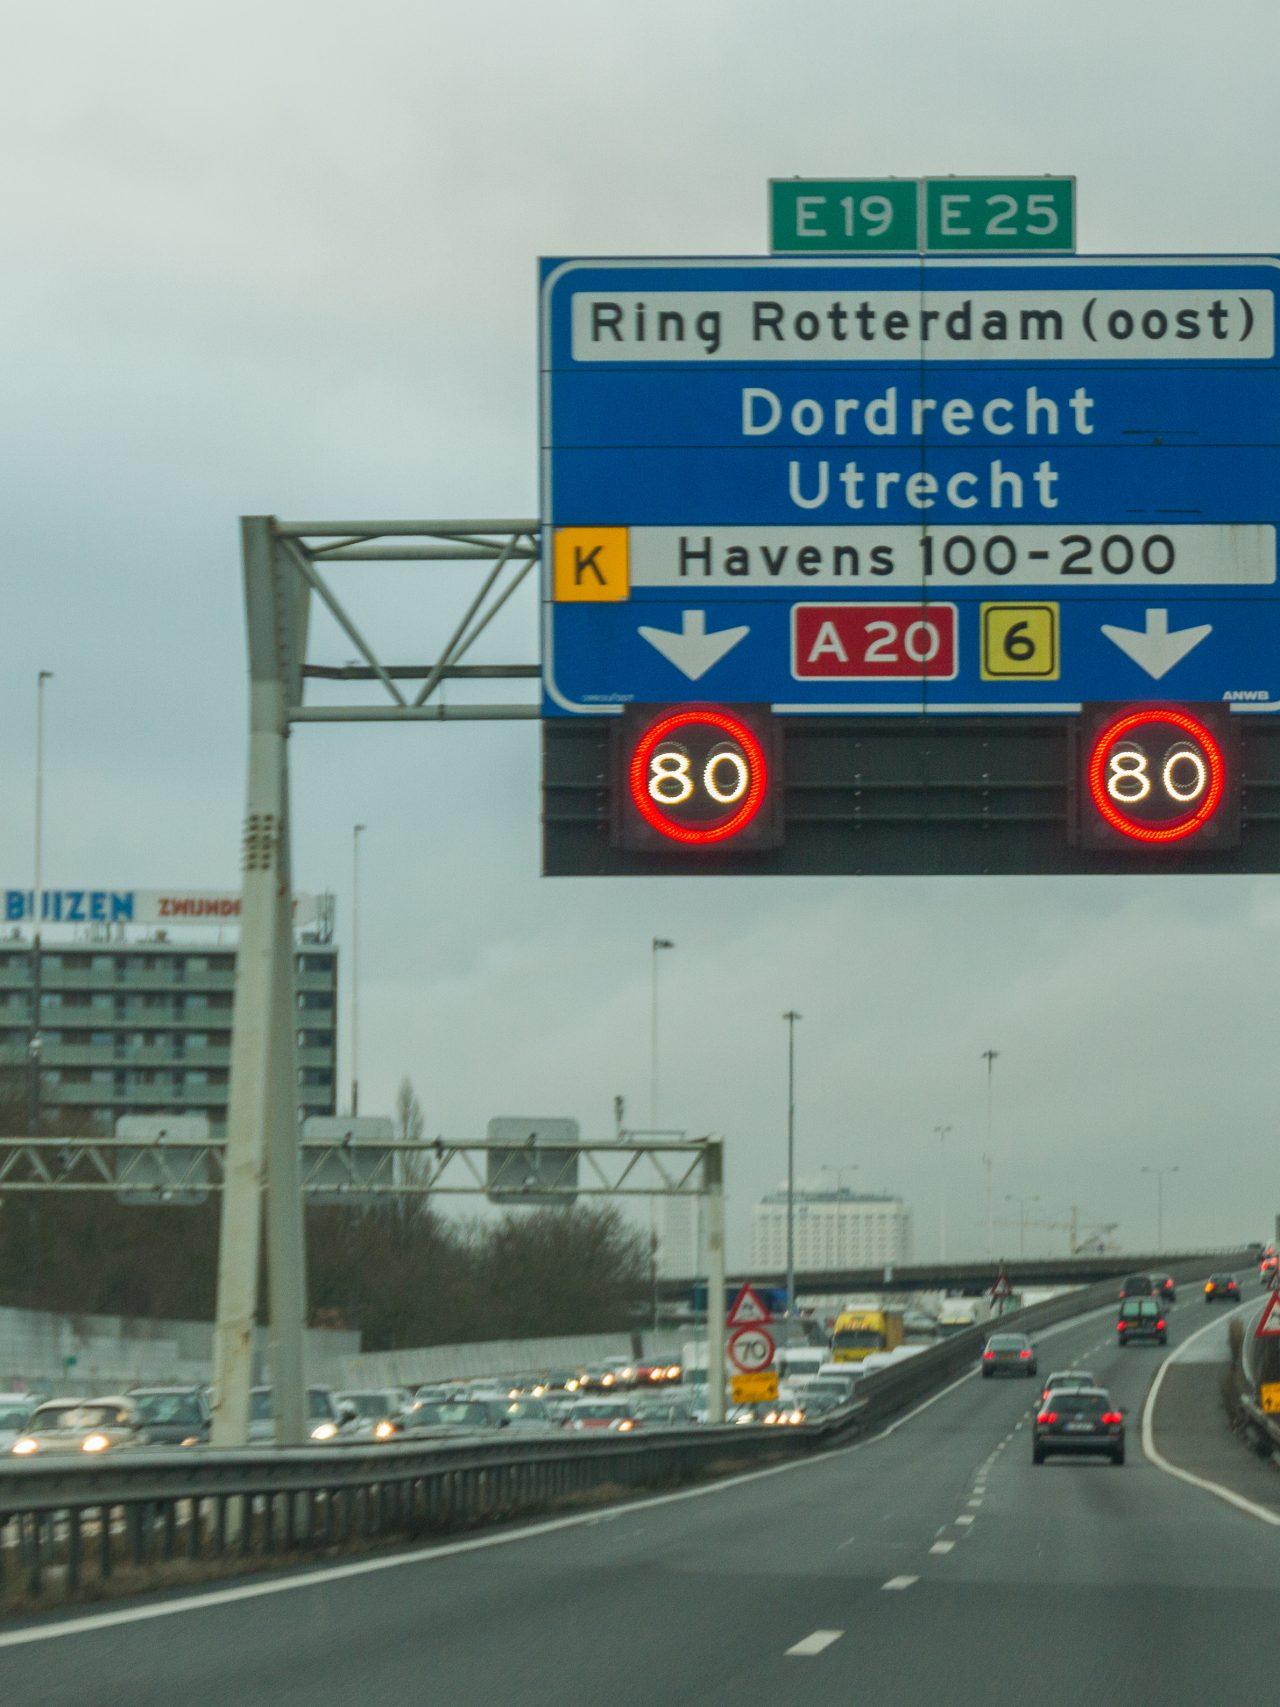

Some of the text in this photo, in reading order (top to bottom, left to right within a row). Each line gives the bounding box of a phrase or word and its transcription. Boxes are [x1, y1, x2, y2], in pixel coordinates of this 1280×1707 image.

[796, 195, 894, 237] E 19
[940, 194, 1058, 236] E 25
[591, 297, 1255, 355] Ring Rotterdam (oost)
[742, 386, 1095, 437] Dordrecht
[788, 459, 1059, 509] Utrecht
[573, 545, 607, 586] K
[679, 534, 1177, 577] Havens 100-200
[807, 620, 940, 663] A 20
[1003, 620, 1036, 662] 6
[1222, 690, 1270, 701] ANWB
[648, 751, 749, 805] 80
[1107, 750, 1207, 804] 80
[735, 1340, 768, 1362] 70
